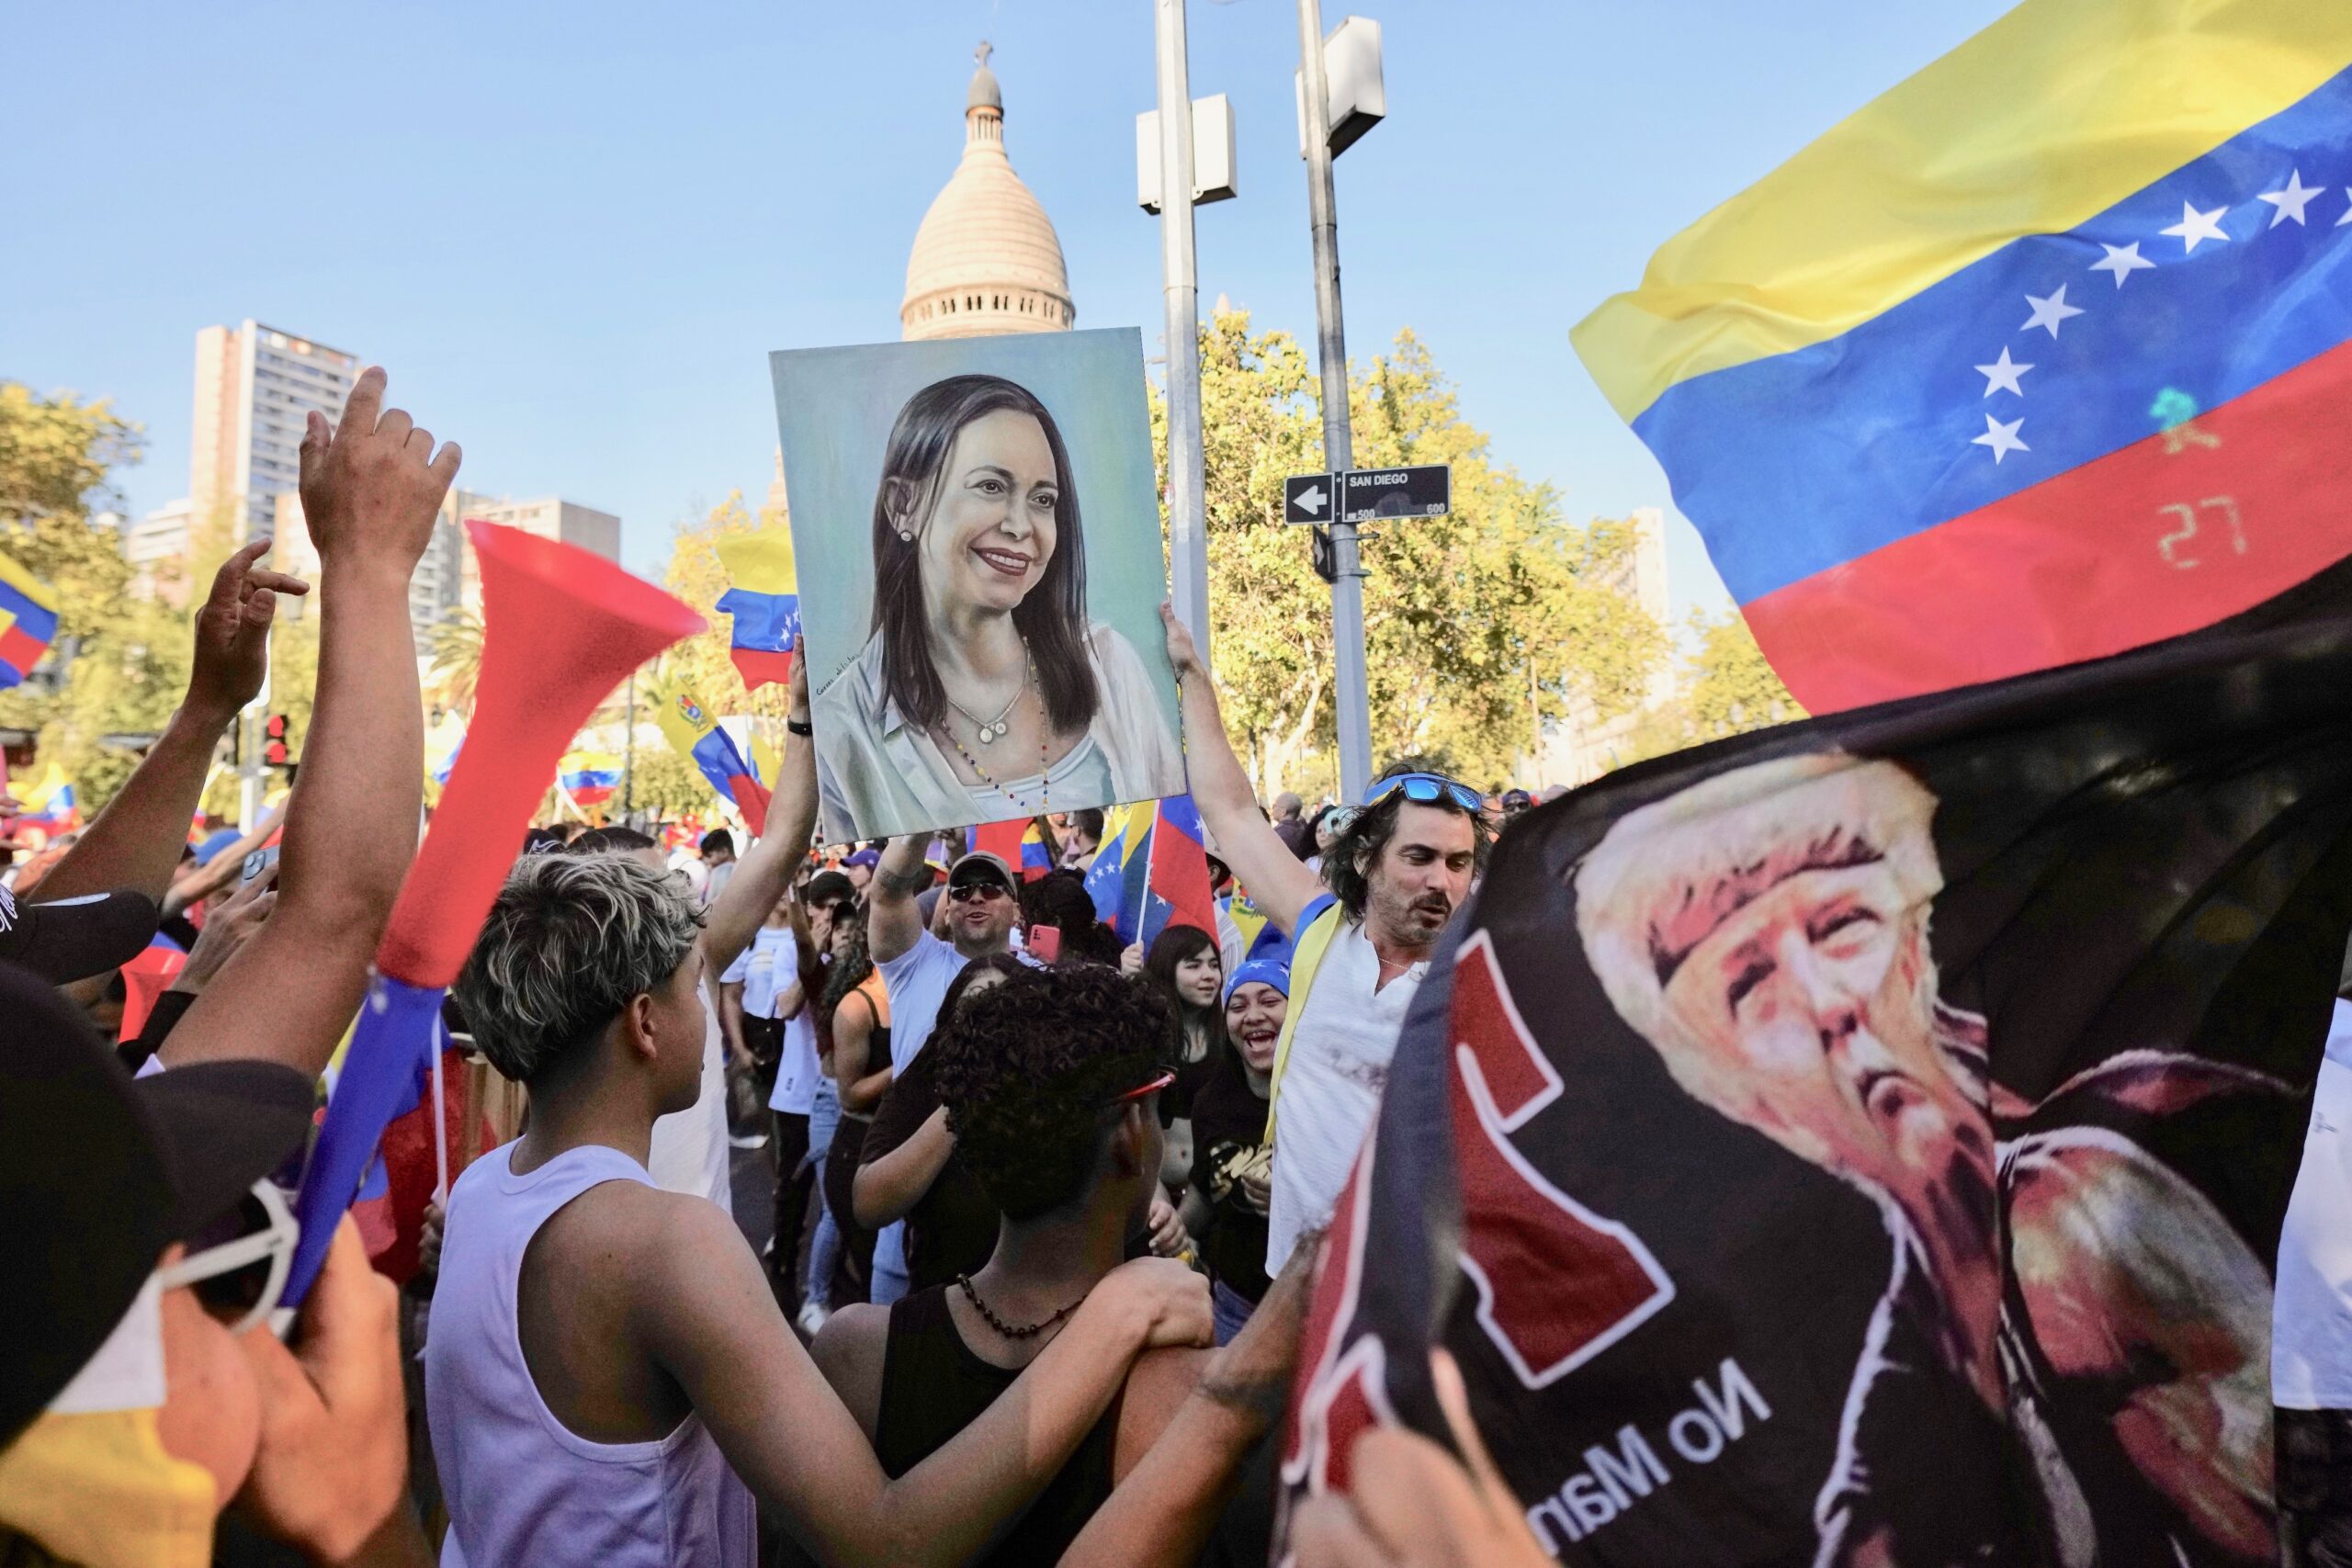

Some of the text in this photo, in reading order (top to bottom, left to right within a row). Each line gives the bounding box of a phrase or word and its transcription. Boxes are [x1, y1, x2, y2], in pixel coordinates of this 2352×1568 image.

[1350, 473, 1408, 487] SAN DIEGO
[1358, 509, 1375, 519] 500
[1426, 502, 1445, 514] 600
[2158, 495, 2247, 570] 27
